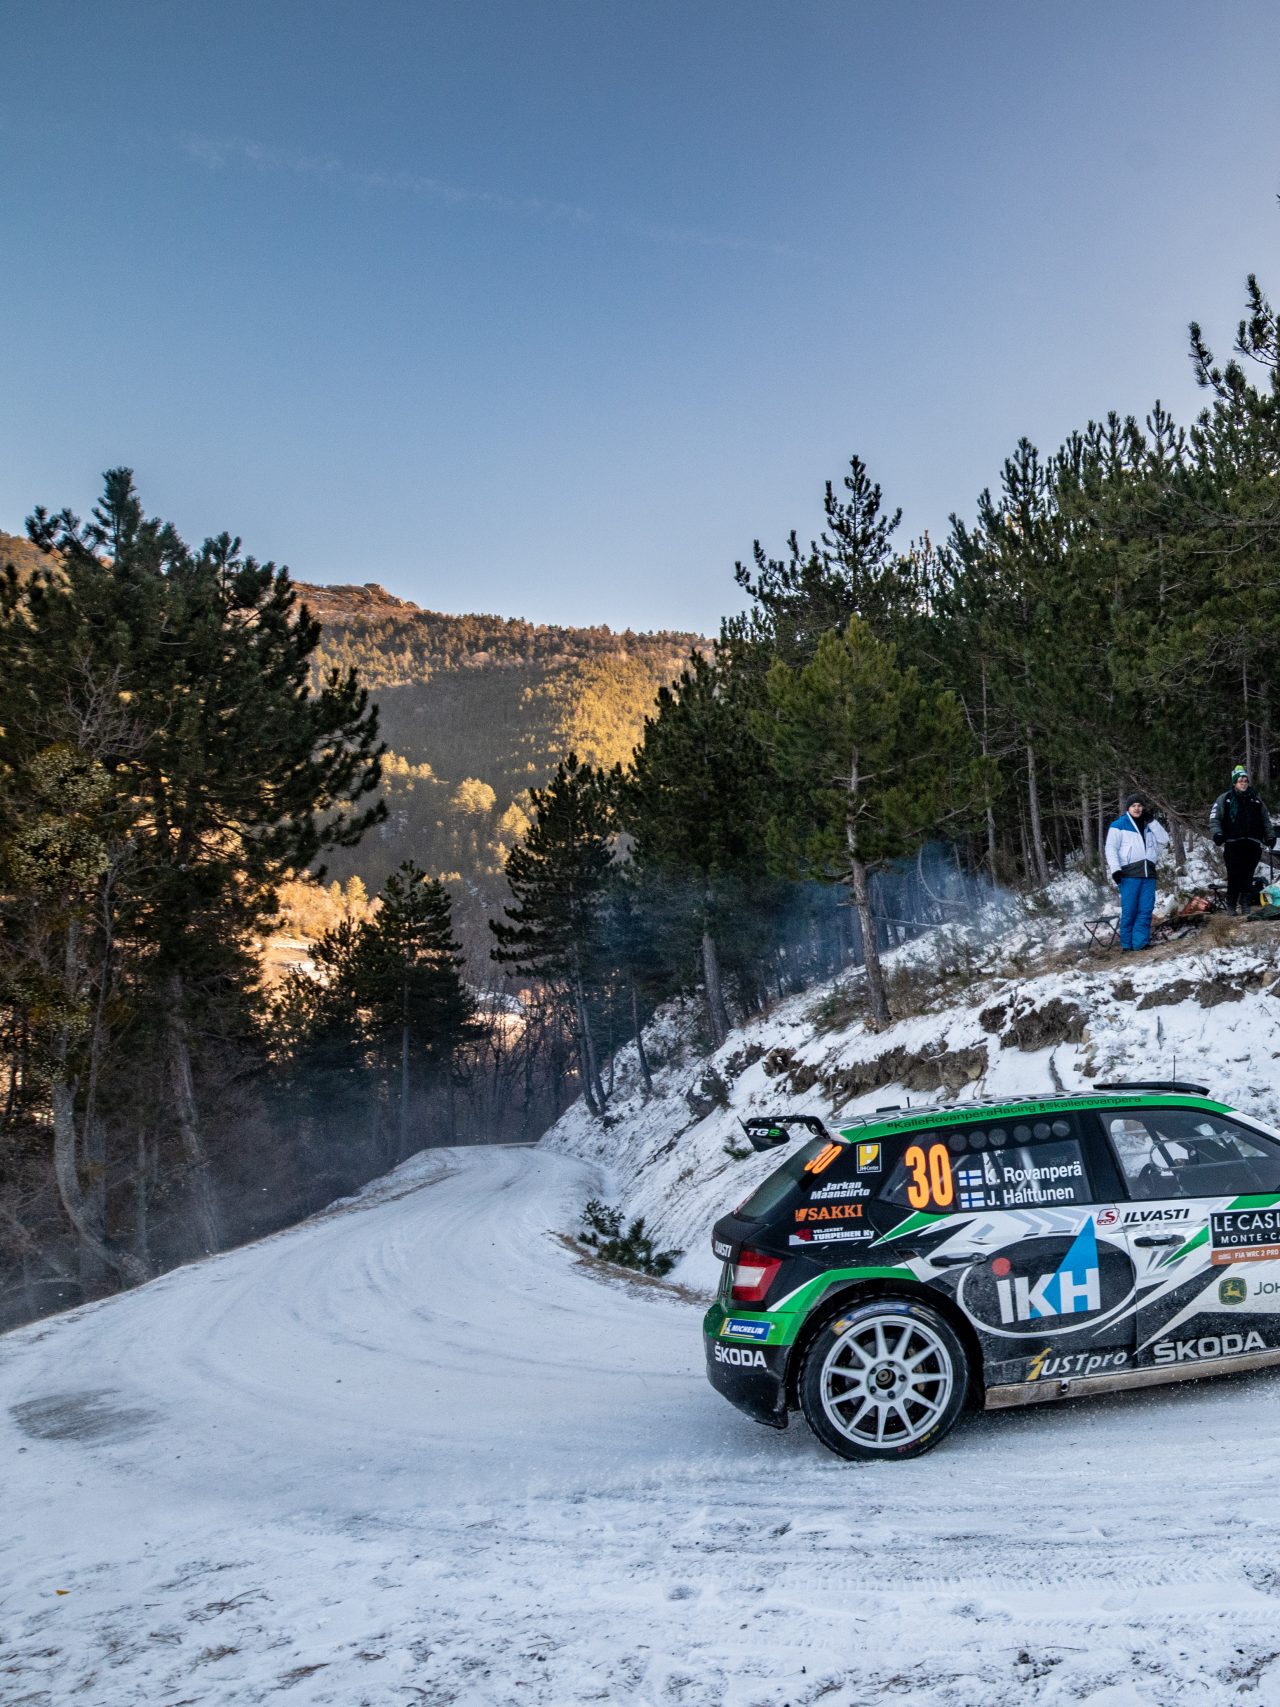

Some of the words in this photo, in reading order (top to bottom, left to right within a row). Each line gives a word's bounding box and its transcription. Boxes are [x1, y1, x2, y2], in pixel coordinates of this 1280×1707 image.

[804, 1143, 843, 1174] 30
[905, 1144, 954, 1209] 30
[1003, 1161, 1082, 1183] Rovanperä
[810, 1188, 870, 1200] Maansiirto
[822, 1181, 863, 1192] Jarkan
[986, 1193, 999, 1207] J.
[1003, 1187, 1075, 1205] Halttunen
[808, 1204, 863, 1221] SAKKI
[1123, 1208, 1190, 1223] ILVASTI
[1213, 1215, 1233, 1232] LE
[1246, 1250, 1259, 1258] WRC
[731, 1324, 764, 1335] MICHELIN
[714, 1341, 768, 1368] ŠKODA
[1153, 1331, 1267, 1364] ŠKODA
